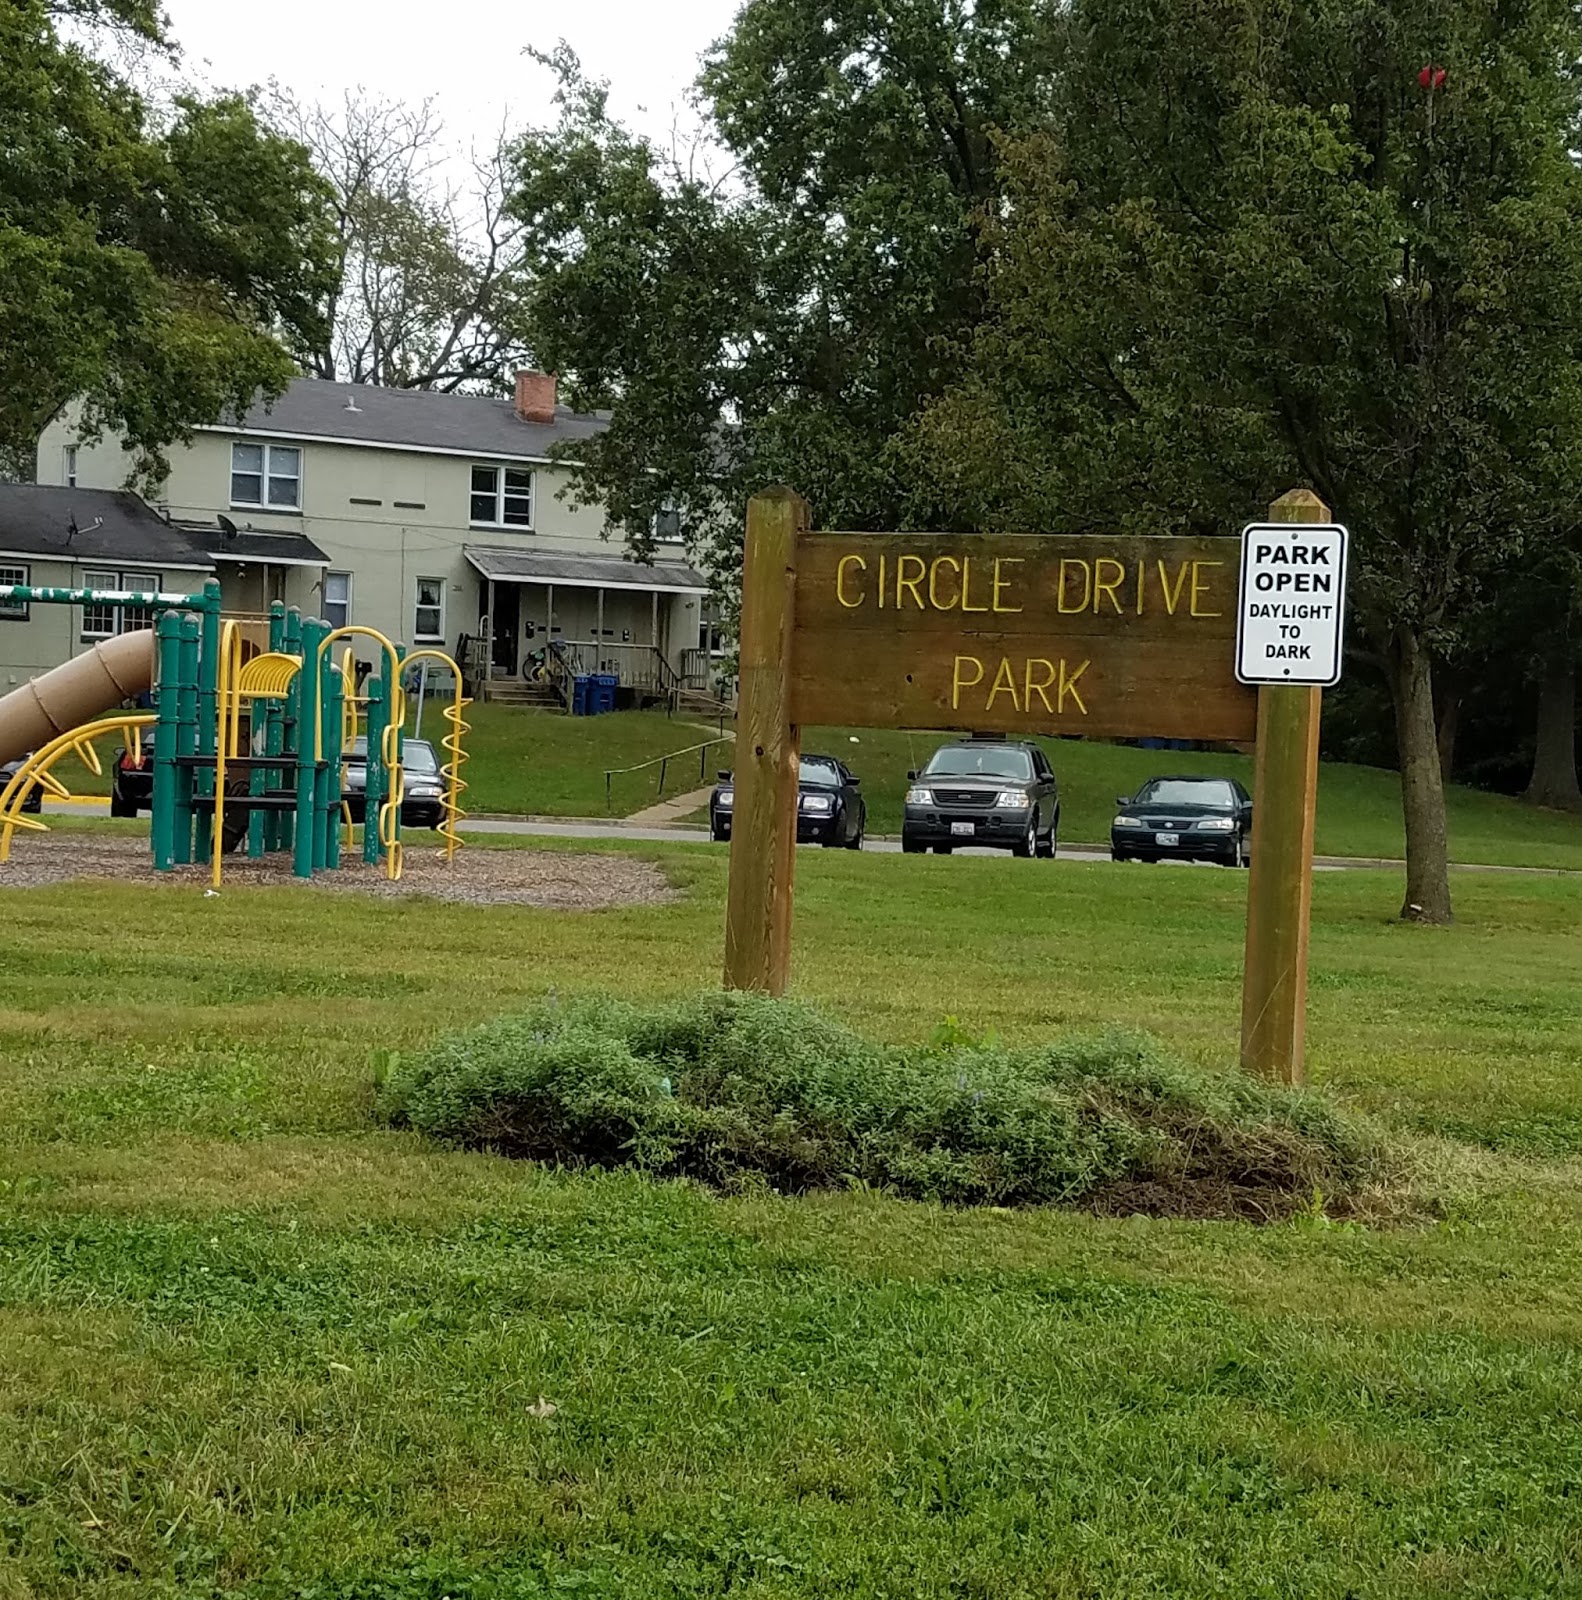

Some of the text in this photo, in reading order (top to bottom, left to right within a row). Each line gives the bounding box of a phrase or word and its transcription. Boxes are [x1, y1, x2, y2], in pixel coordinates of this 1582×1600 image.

[1256, 545, 1330, 565] PARK
[835, 554, 1223, 618] CIRCLE DRIVE
[1255, 572, 1331, 593] OPEN
[1249, 603, 1333, 620] DAYLIGHT
[1279, 625, 1301, 639] TO
[1265, 644, 1311, 660] DARK
[950, 656, 1092, 716] PARK
